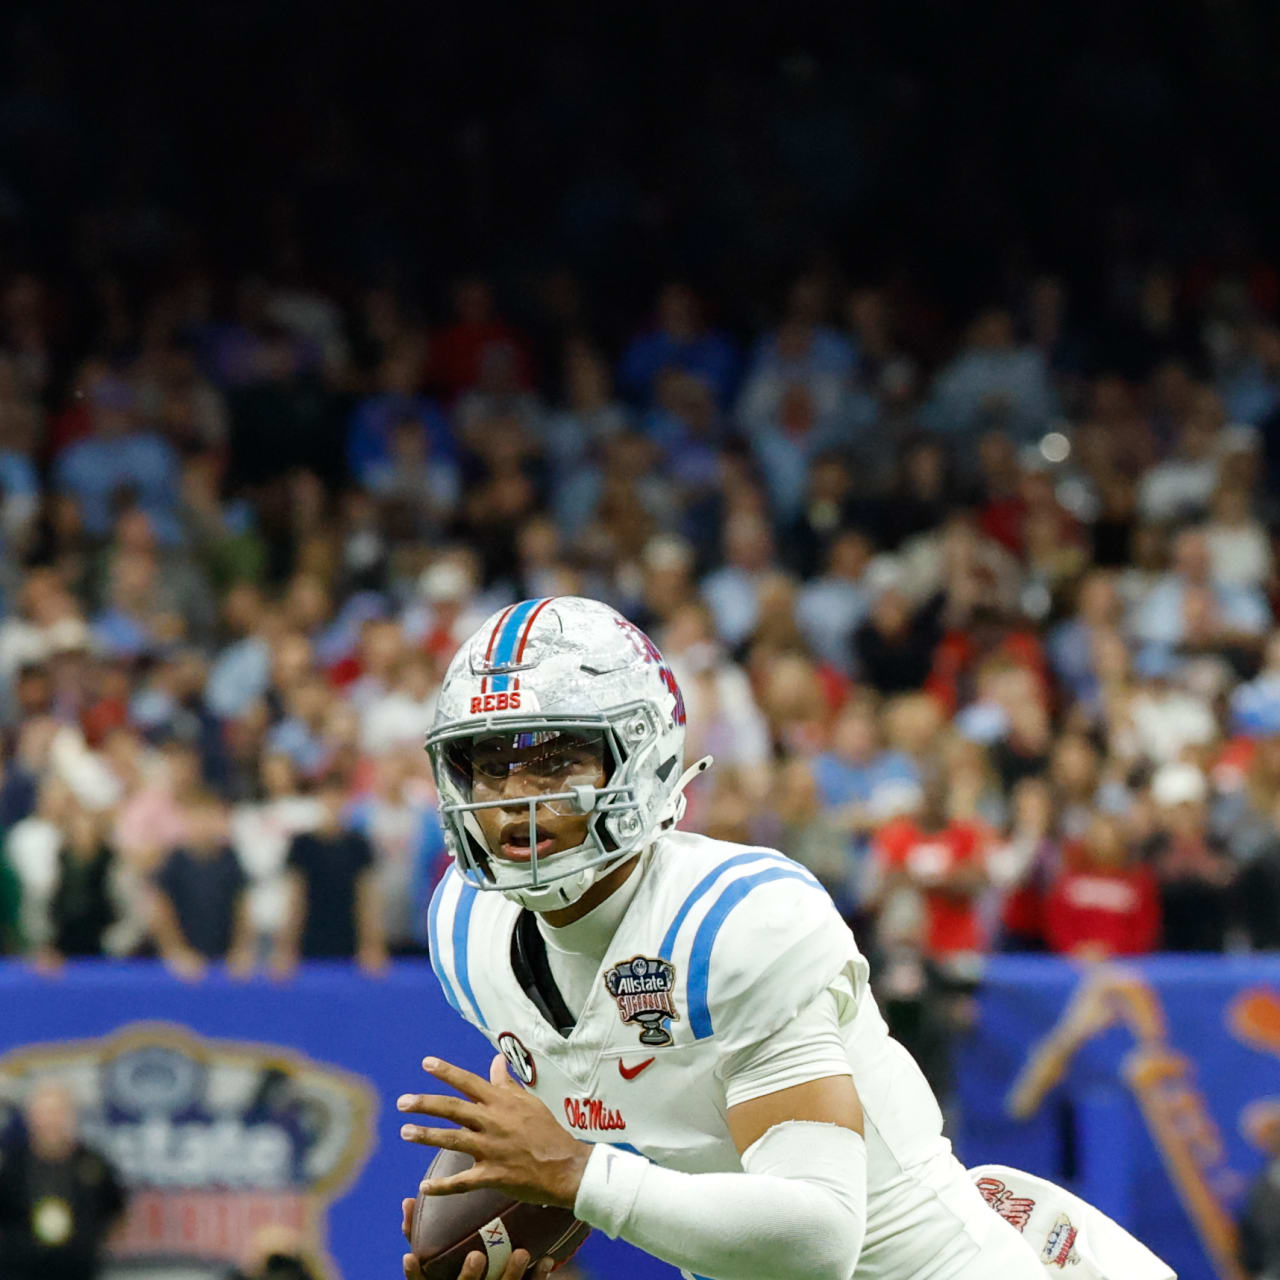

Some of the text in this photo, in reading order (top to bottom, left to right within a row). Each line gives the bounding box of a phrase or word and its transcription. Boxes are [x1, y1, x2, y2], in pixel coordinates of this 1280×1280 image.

[469, 691, 522, 715] REBS
[617, 975, 666, 995] Allstate
[563, 1097, 627, 1131] Ole Miss
